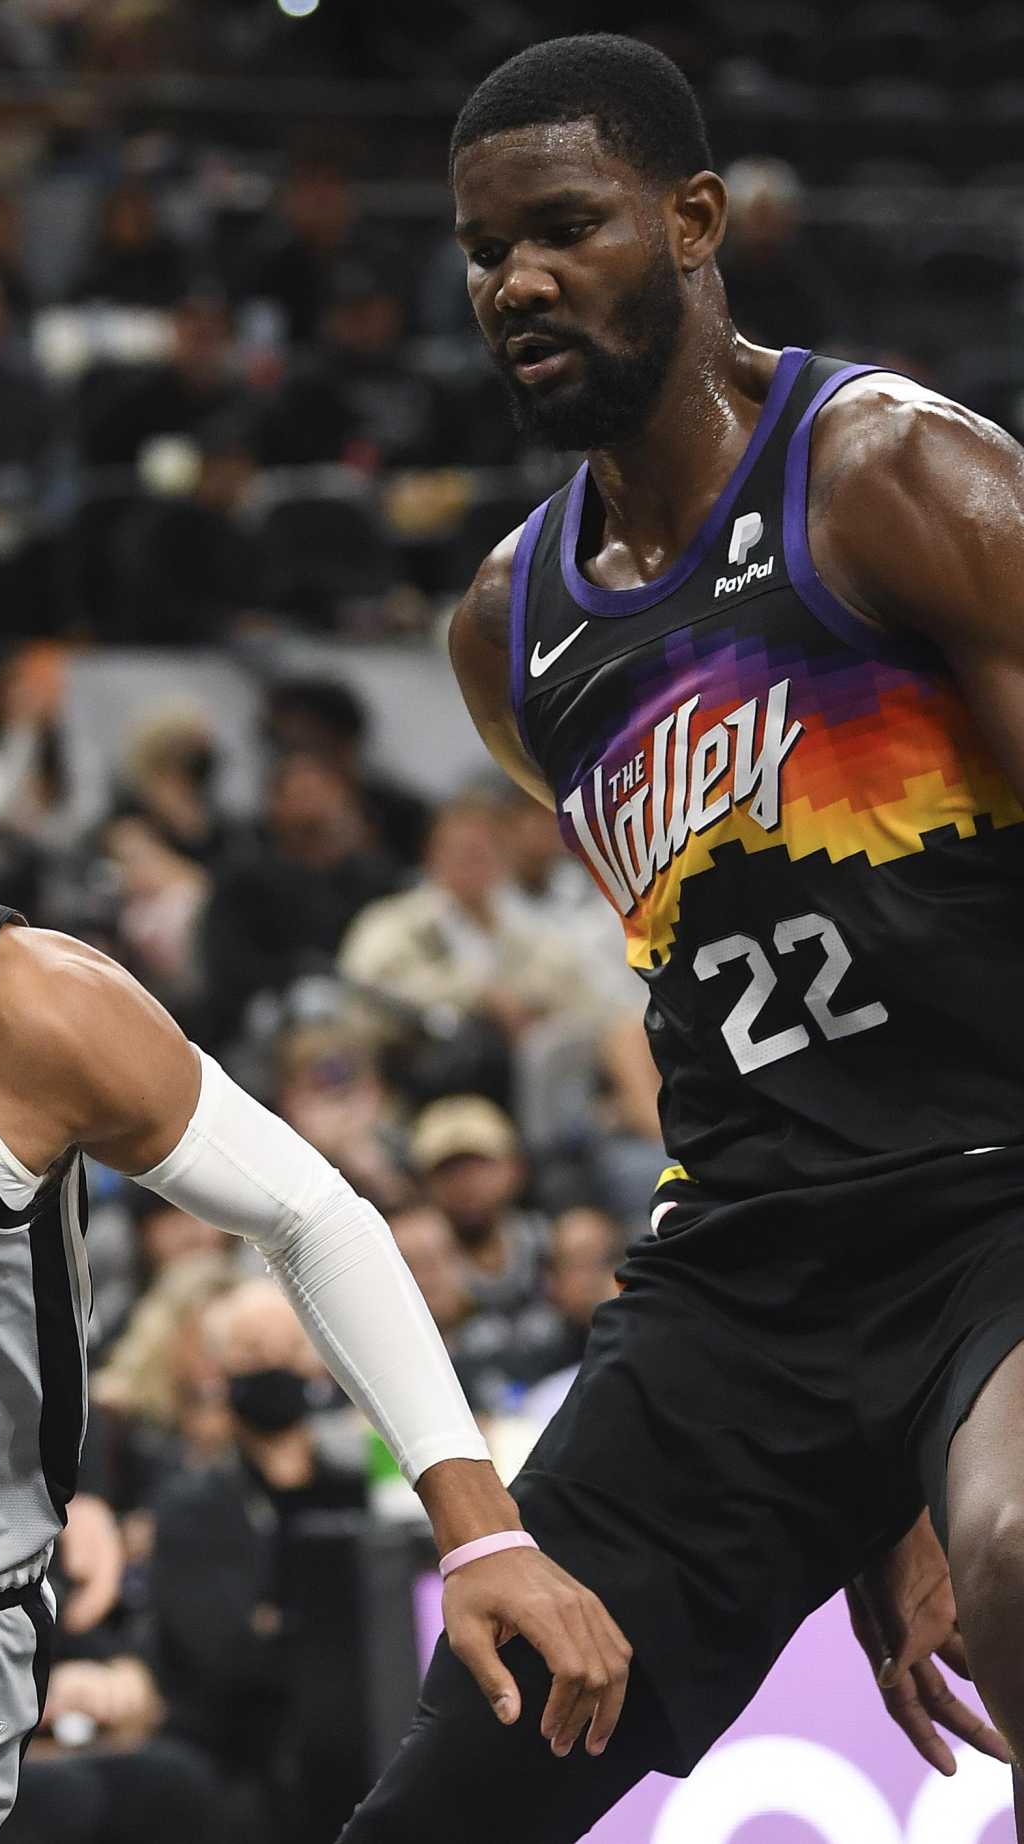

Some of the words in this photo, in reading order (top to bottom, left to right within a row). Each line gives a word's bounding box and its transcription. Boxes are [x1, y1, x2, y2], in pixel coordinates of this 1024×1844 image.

[714, 555, 775, 598] PayPal
[563, 678, 805, 916] Valley
[608, 751, 645, 802] THE
[692, 912, 888, 1075] 22
